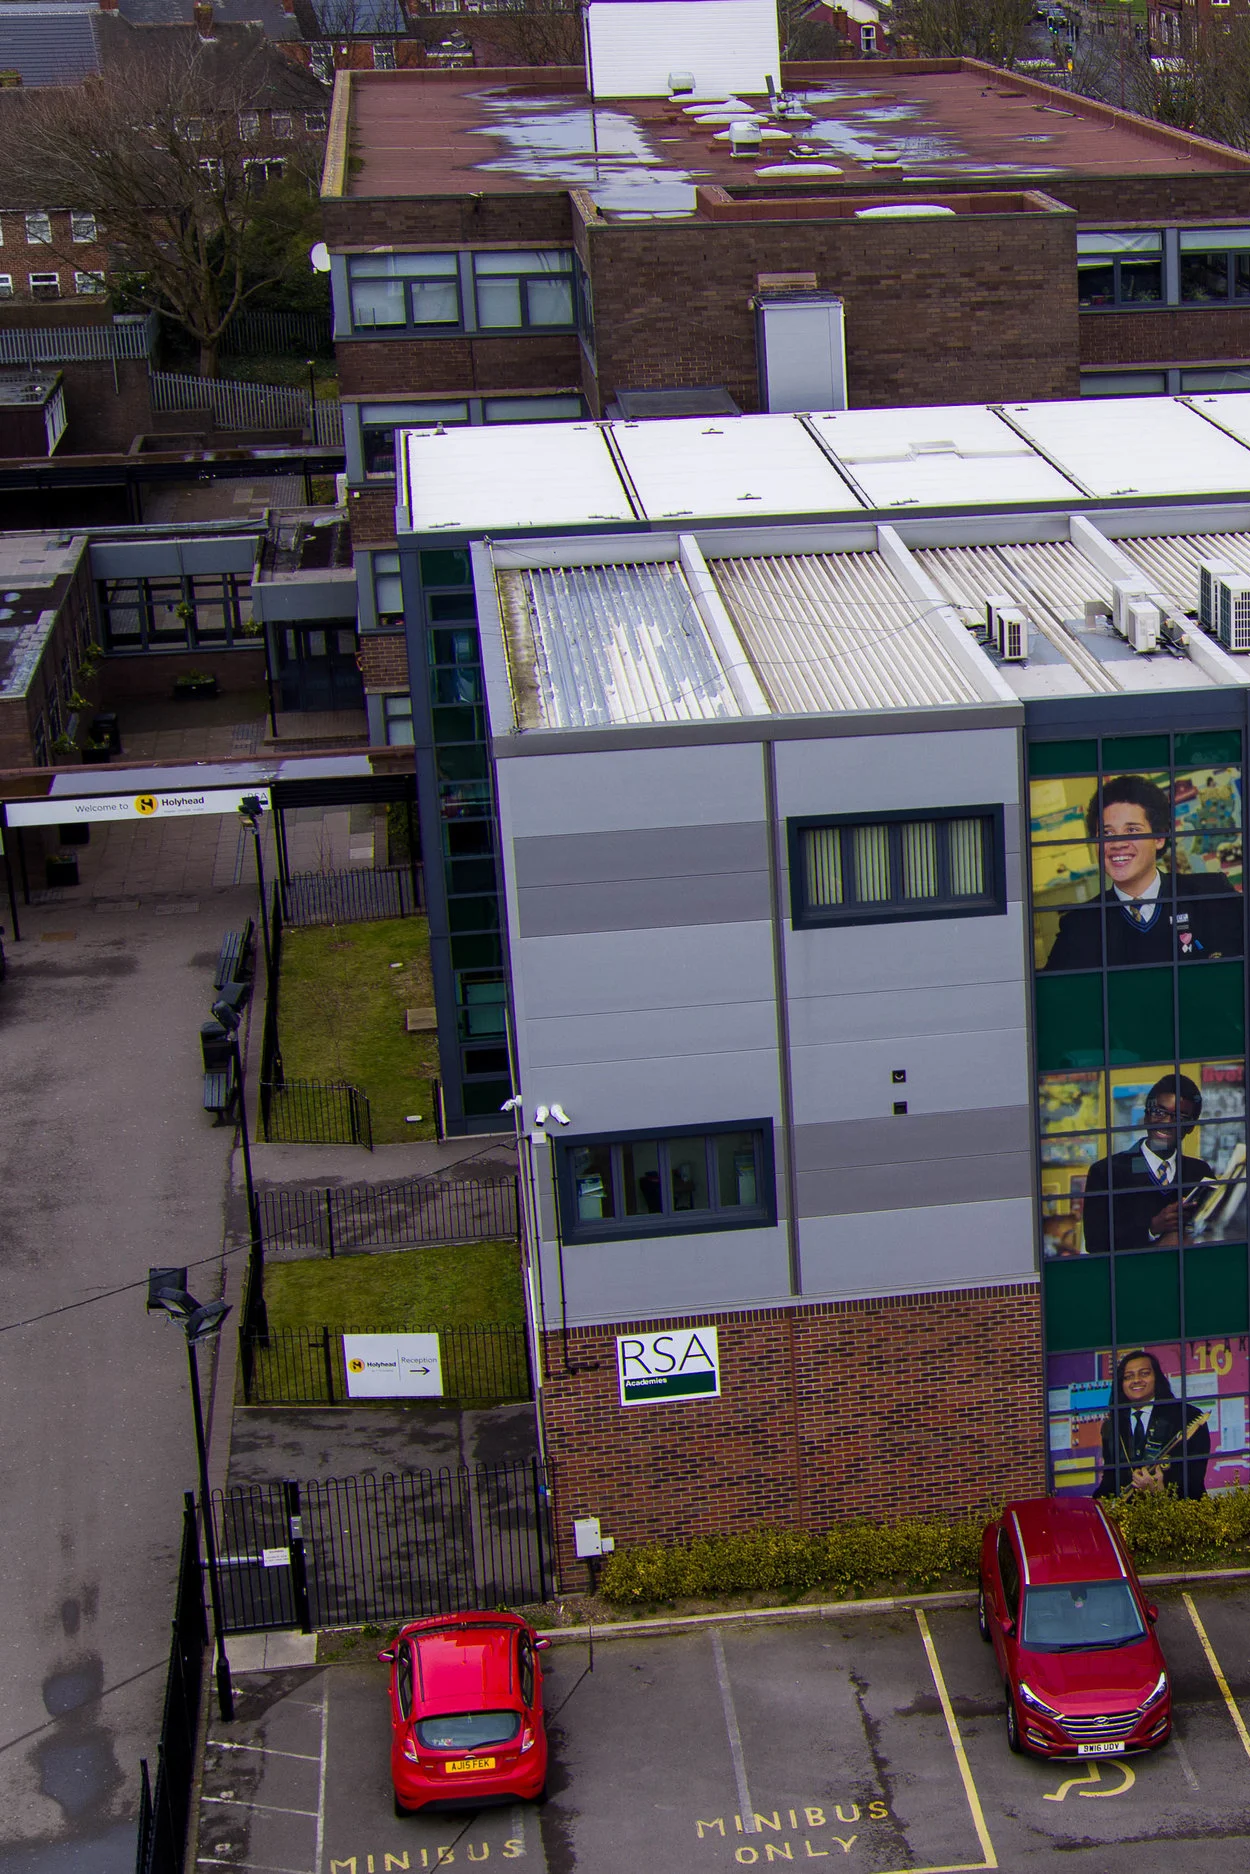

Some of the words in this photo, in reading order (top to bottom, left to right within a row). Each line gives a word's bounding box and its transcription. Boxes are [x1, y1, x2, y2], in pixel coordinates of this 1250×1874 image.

[75, 804, 117, 812] Welcome
[161, 796, 205, 807] Holyhead
[400, 1356, 438, 1364] Reception
[621, 1333, 715, 1377] RSA
[1195, 1343, 1233, 1376] 10
[625, 1377, 668, 1387] Academies
[451, 1761, 471, 1771] AJ15
[472, 1758, 490, 1768] FEK
[696, 1801, 889, 1839] MINIBUS
[329, 1838, 525, 1874] MINIBUS
[735, 1835, 858, 1864] ONLY
